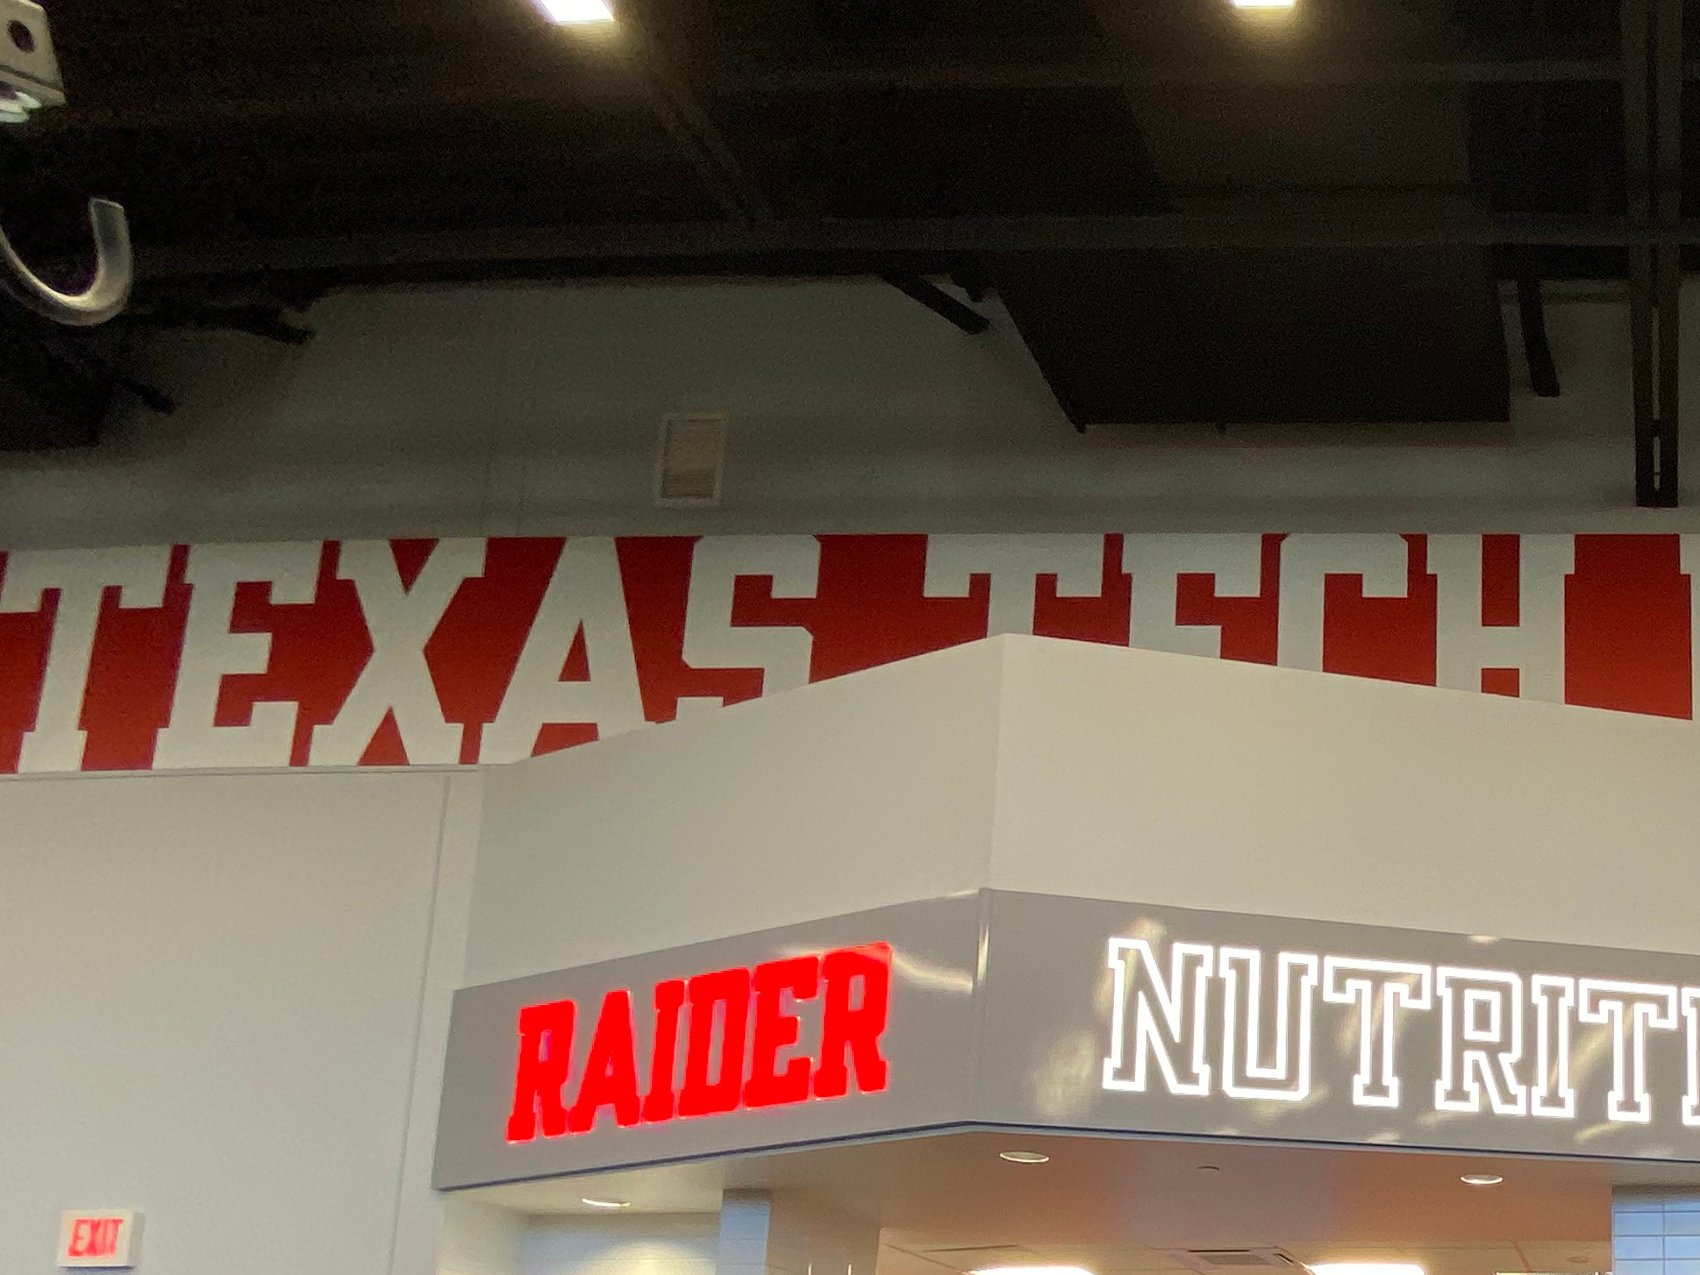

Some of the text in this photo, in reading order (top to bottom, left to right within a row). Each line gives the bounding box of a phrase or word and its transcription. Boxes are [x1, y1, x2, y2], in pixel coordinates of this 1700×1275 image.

[0, 534, 821, 773] TEXAS
[506, 941, 892, 1143] RAIDER
[67, 1217, 124, 1257] EXIT
